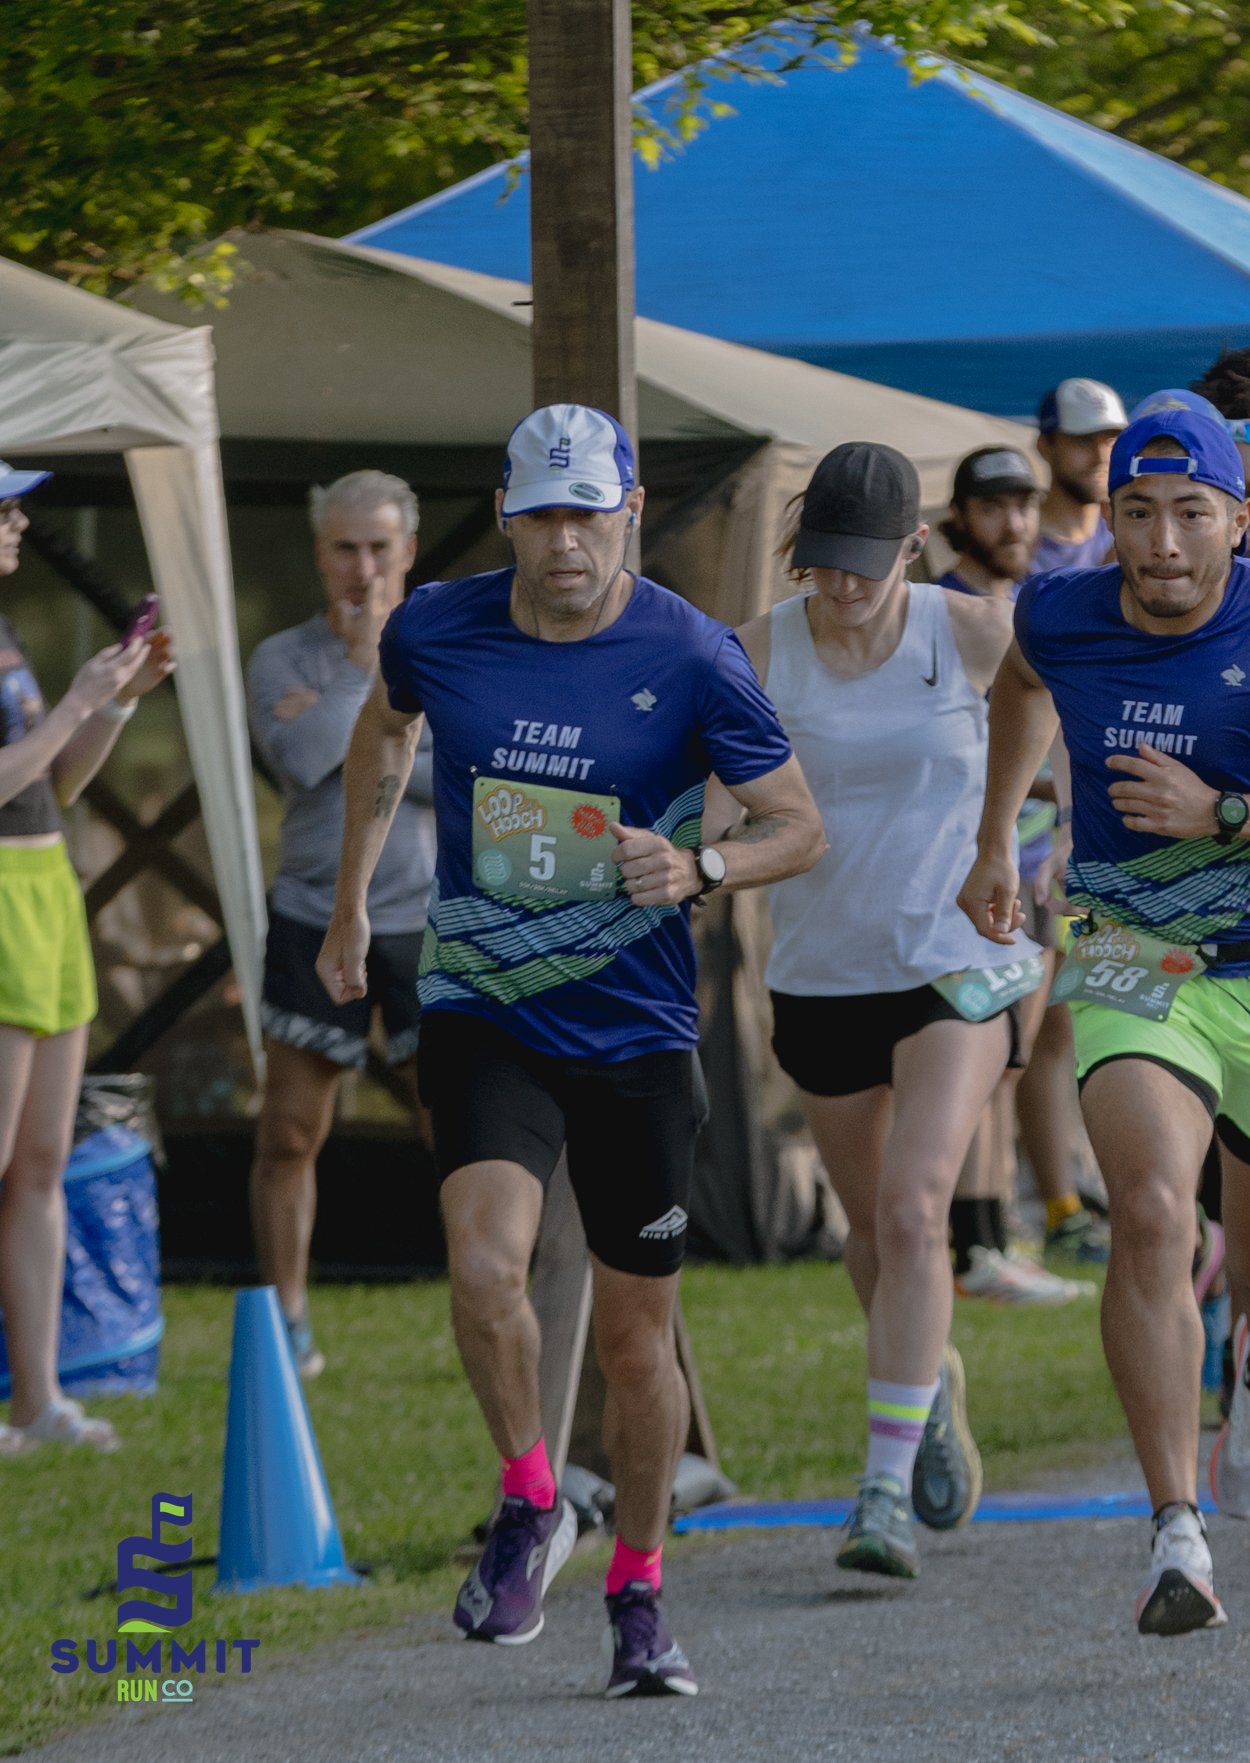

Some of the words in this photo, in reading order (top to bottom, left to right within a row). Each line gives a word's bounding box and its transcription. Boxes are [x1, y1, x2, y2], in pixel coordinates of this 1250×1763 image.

[1122, 700, 1184, 726] TEAM
[512, 719, 582, 749] TEAM
[1104, 727, 1198, 755] SUMMIT
[491, 747, 595, 780] SUMMIT
[478, 788, 524, 824] LOOP
[491, 808, 544, 838] HOOCH
[528, 834, 557, 881] 5
[1084, 959, 1149, 992] 58
